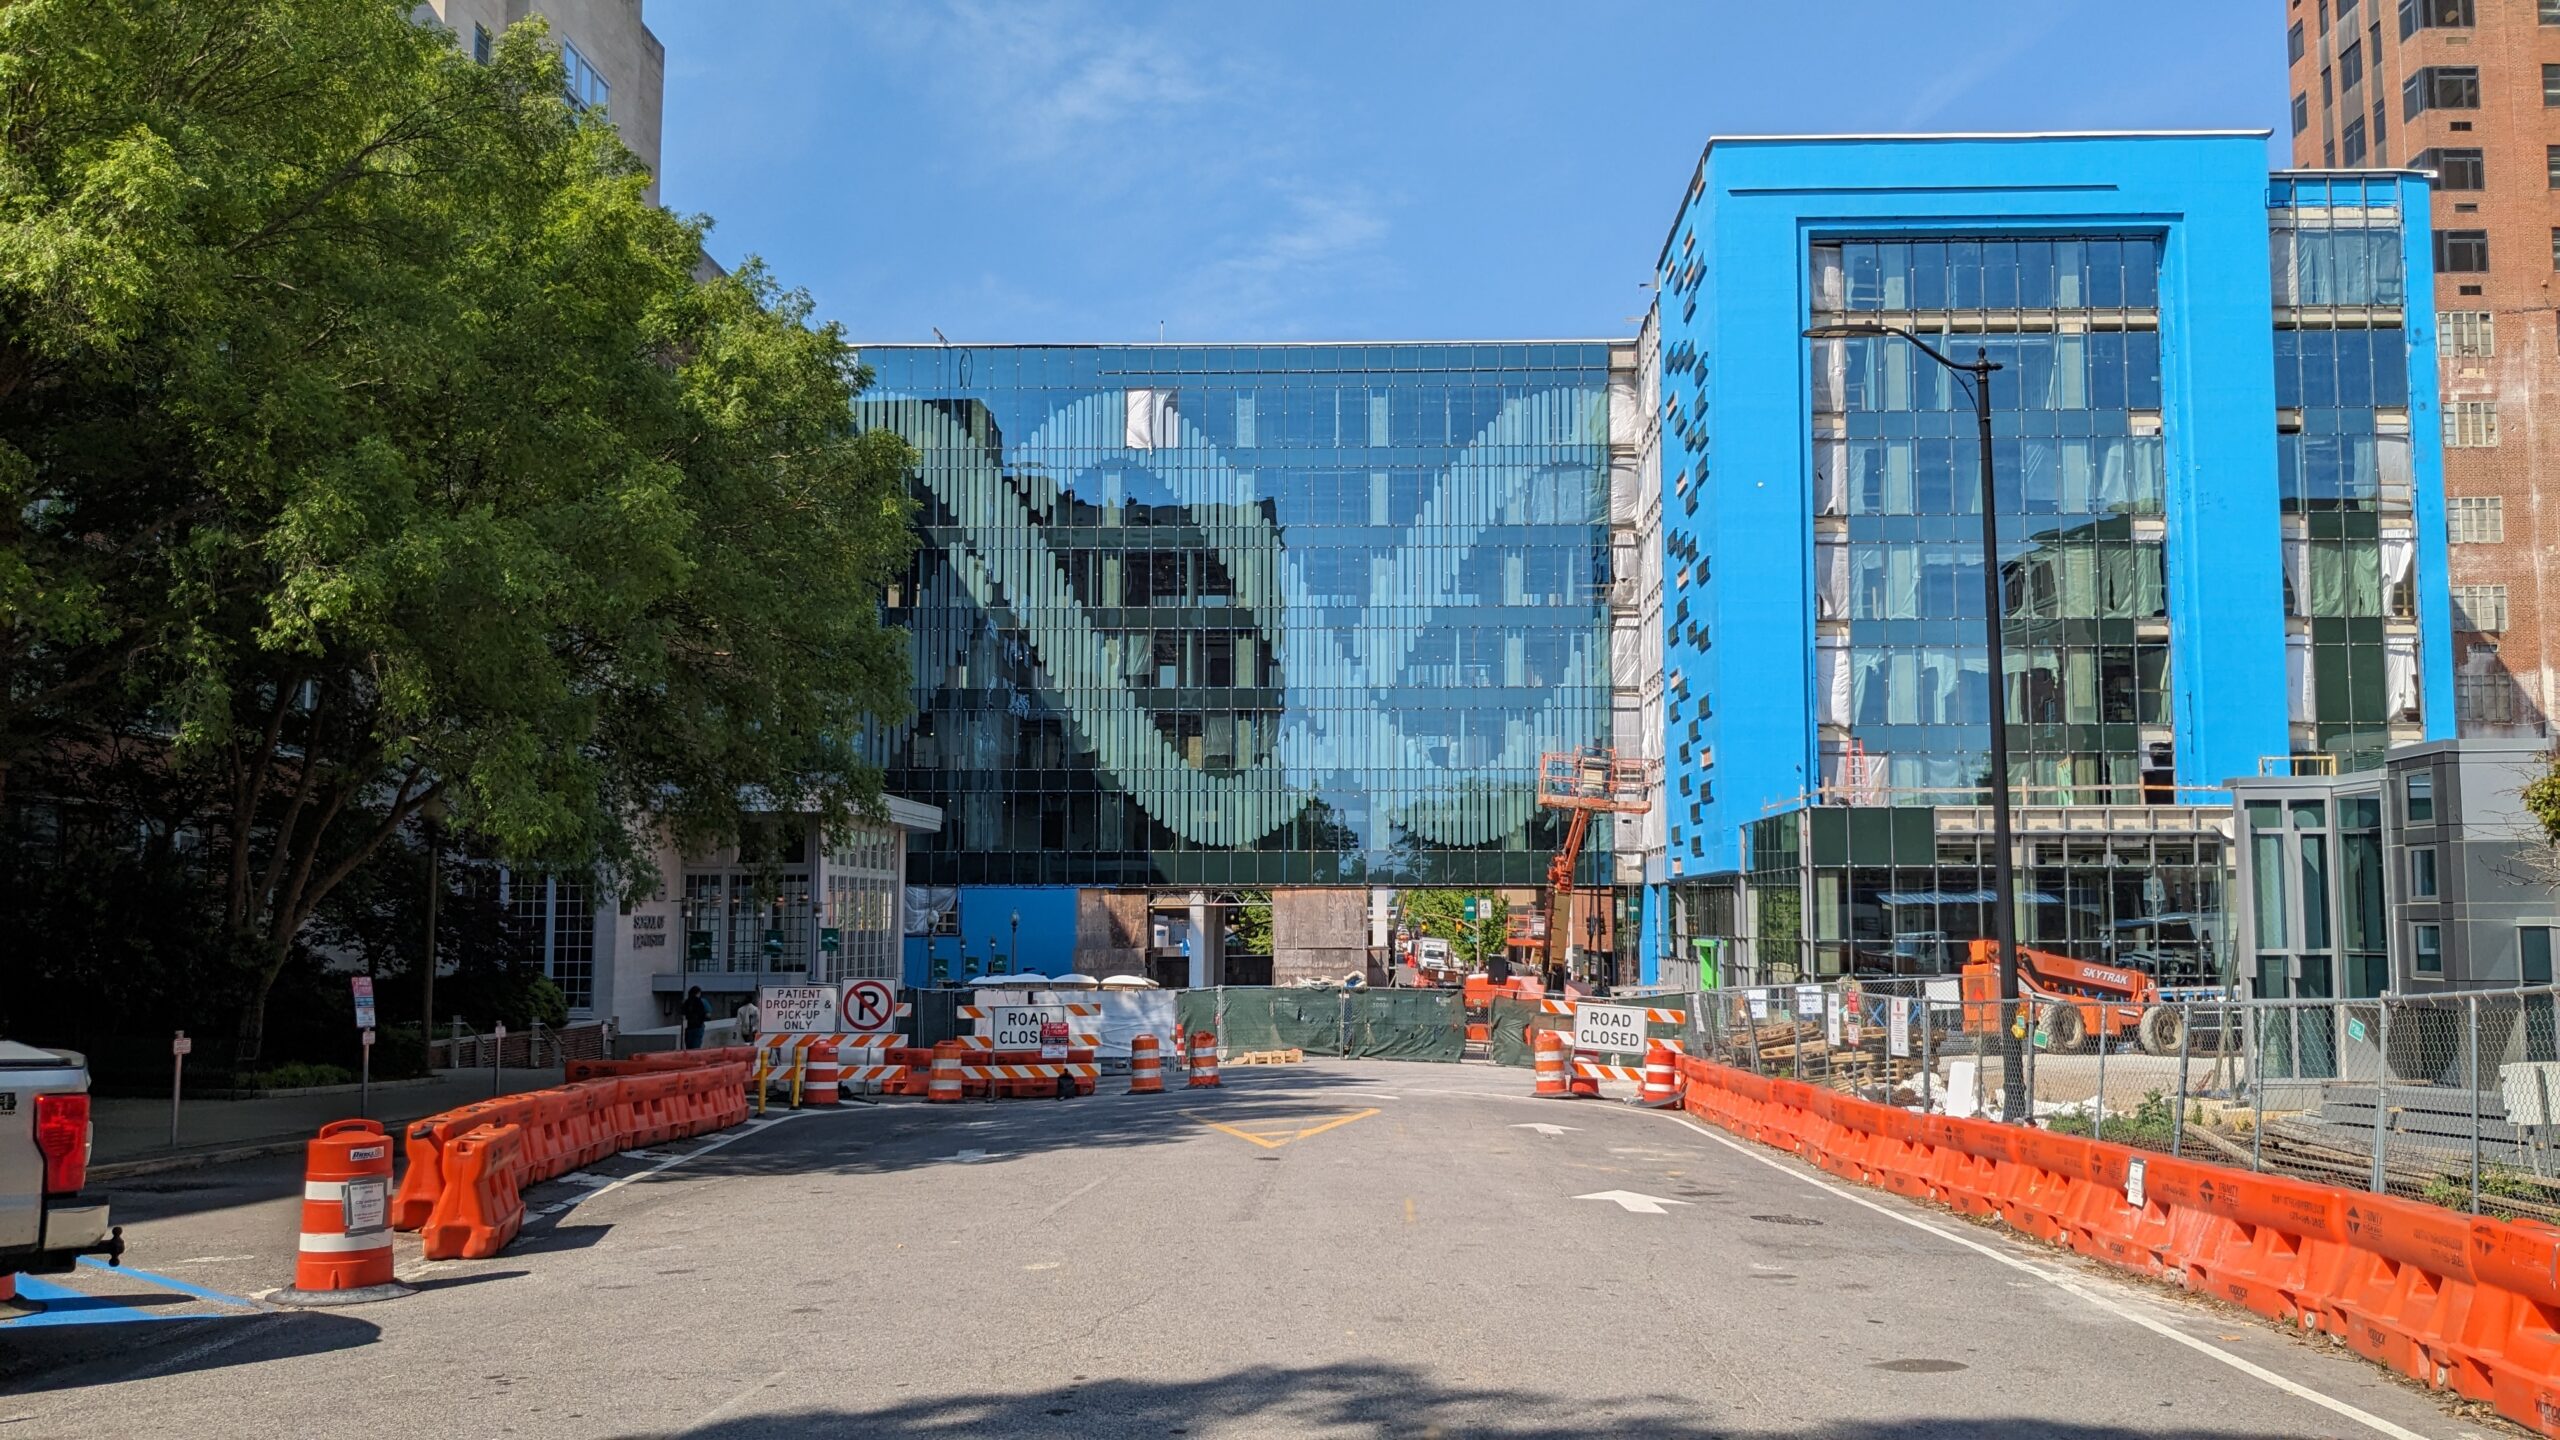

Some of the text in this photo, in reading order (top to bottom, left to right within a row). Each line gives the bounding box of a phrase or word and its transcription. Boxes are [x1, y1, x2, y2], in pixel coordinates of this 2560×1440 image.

[2082, 967, 2129, 985] SKYTRAK
[777, 989, 822, 999] PATIENT
[766, 999, 832, 1009] DROP-OFF &
[777, 1010, 821, 1019] PICK-UP
[1008, 1012, 1050, 1026] ROAD
[1589, 1011, 1632, 1028] ROAD
[784, 1020, 813, 1030] ONLY
[999, 1031, 1043, 1044] CLOS
[1581, 1029, 1640, 1047] CLOSED
